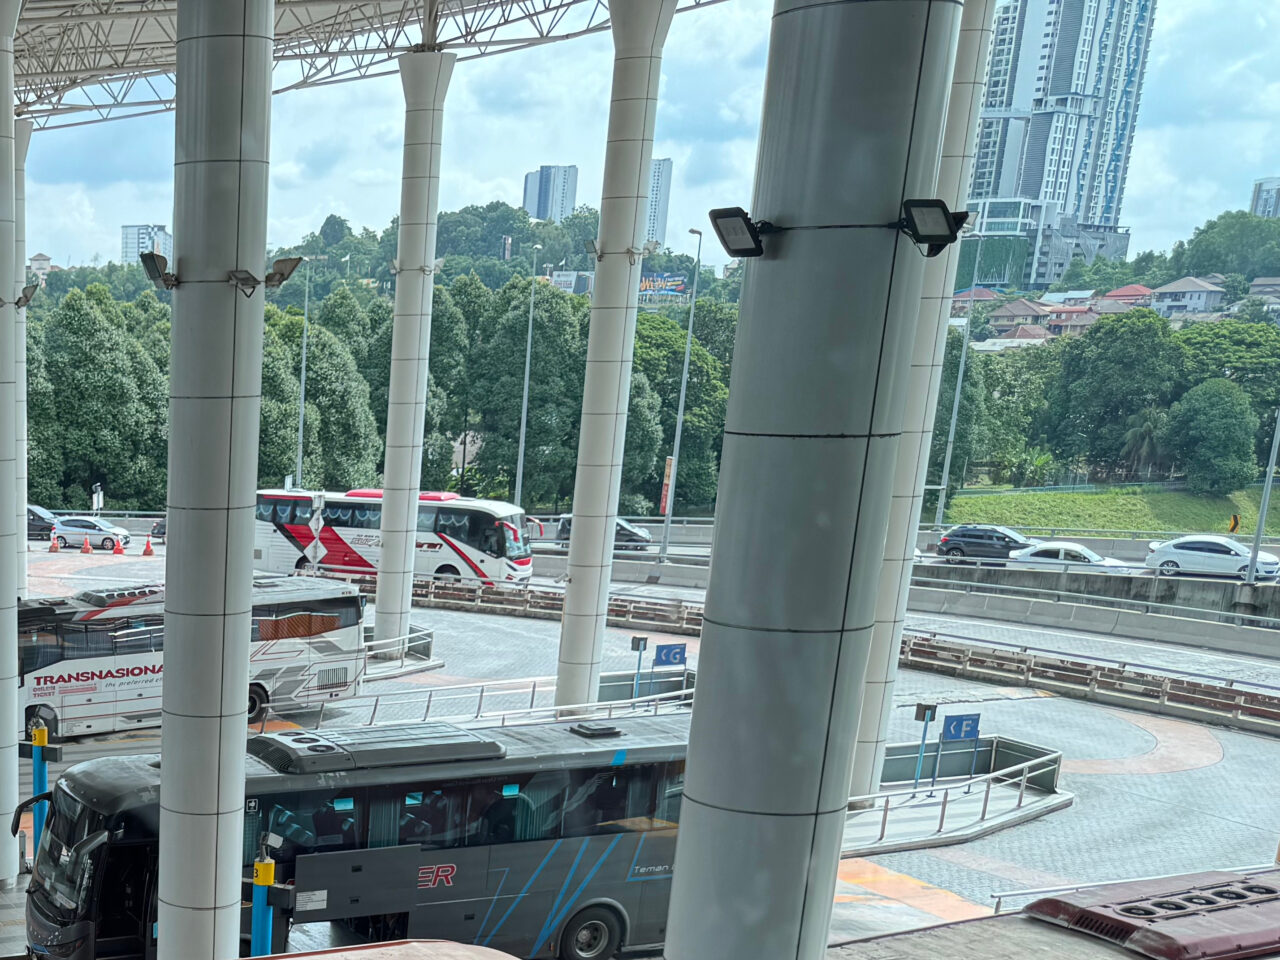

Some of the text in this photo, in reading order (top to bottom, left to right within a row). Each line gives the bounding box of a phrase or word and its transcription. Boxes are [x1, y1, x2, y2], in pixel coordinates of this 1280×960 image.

[670, 648, 680, 663] G
[118, 679, 154, 687] preferred
[961, 720, 972, 737] F
[634, 865, 668, 873] Teman
